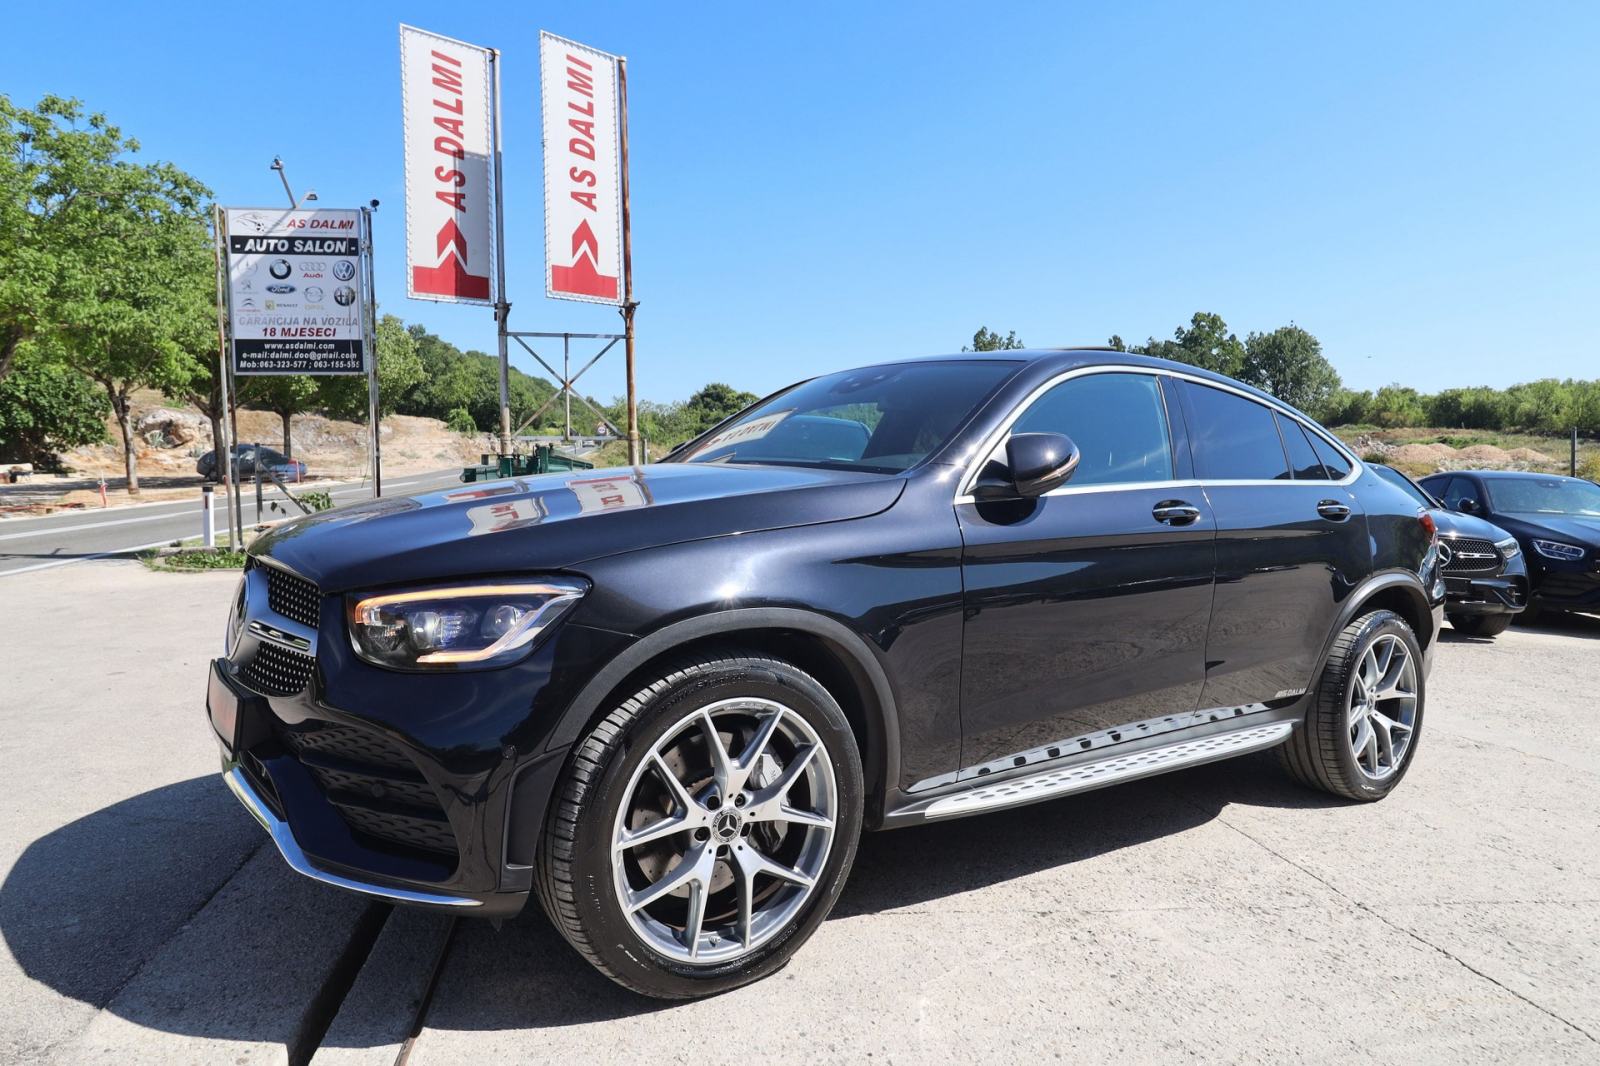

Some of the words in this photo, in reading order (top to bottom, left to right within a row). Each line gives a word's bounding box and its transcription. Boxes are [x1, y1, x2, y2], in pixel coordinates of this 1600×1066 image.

[431, 50, 465, 160] DALMI
[565, 54, 596, 161] DALMI
[434, 165, 466, 213] AS
[569, 166, 597, 212] AS
[286, 219, 306, 229] AS
[310, 219, 355, 230] DALMI
[244, 239, 289, 252] AUTO
[293, 240, 347, 253] SALON
[239, 316, 299, 327] GARANCIJA
[303, 317, 318, 327] NA
[322, 316, 358, 327] VOZILA
[262, 327, 276, 337] 18
[281, 327, 337, 338] MJESECI
[264, 342, 335, 350] www.asdalmi.com
